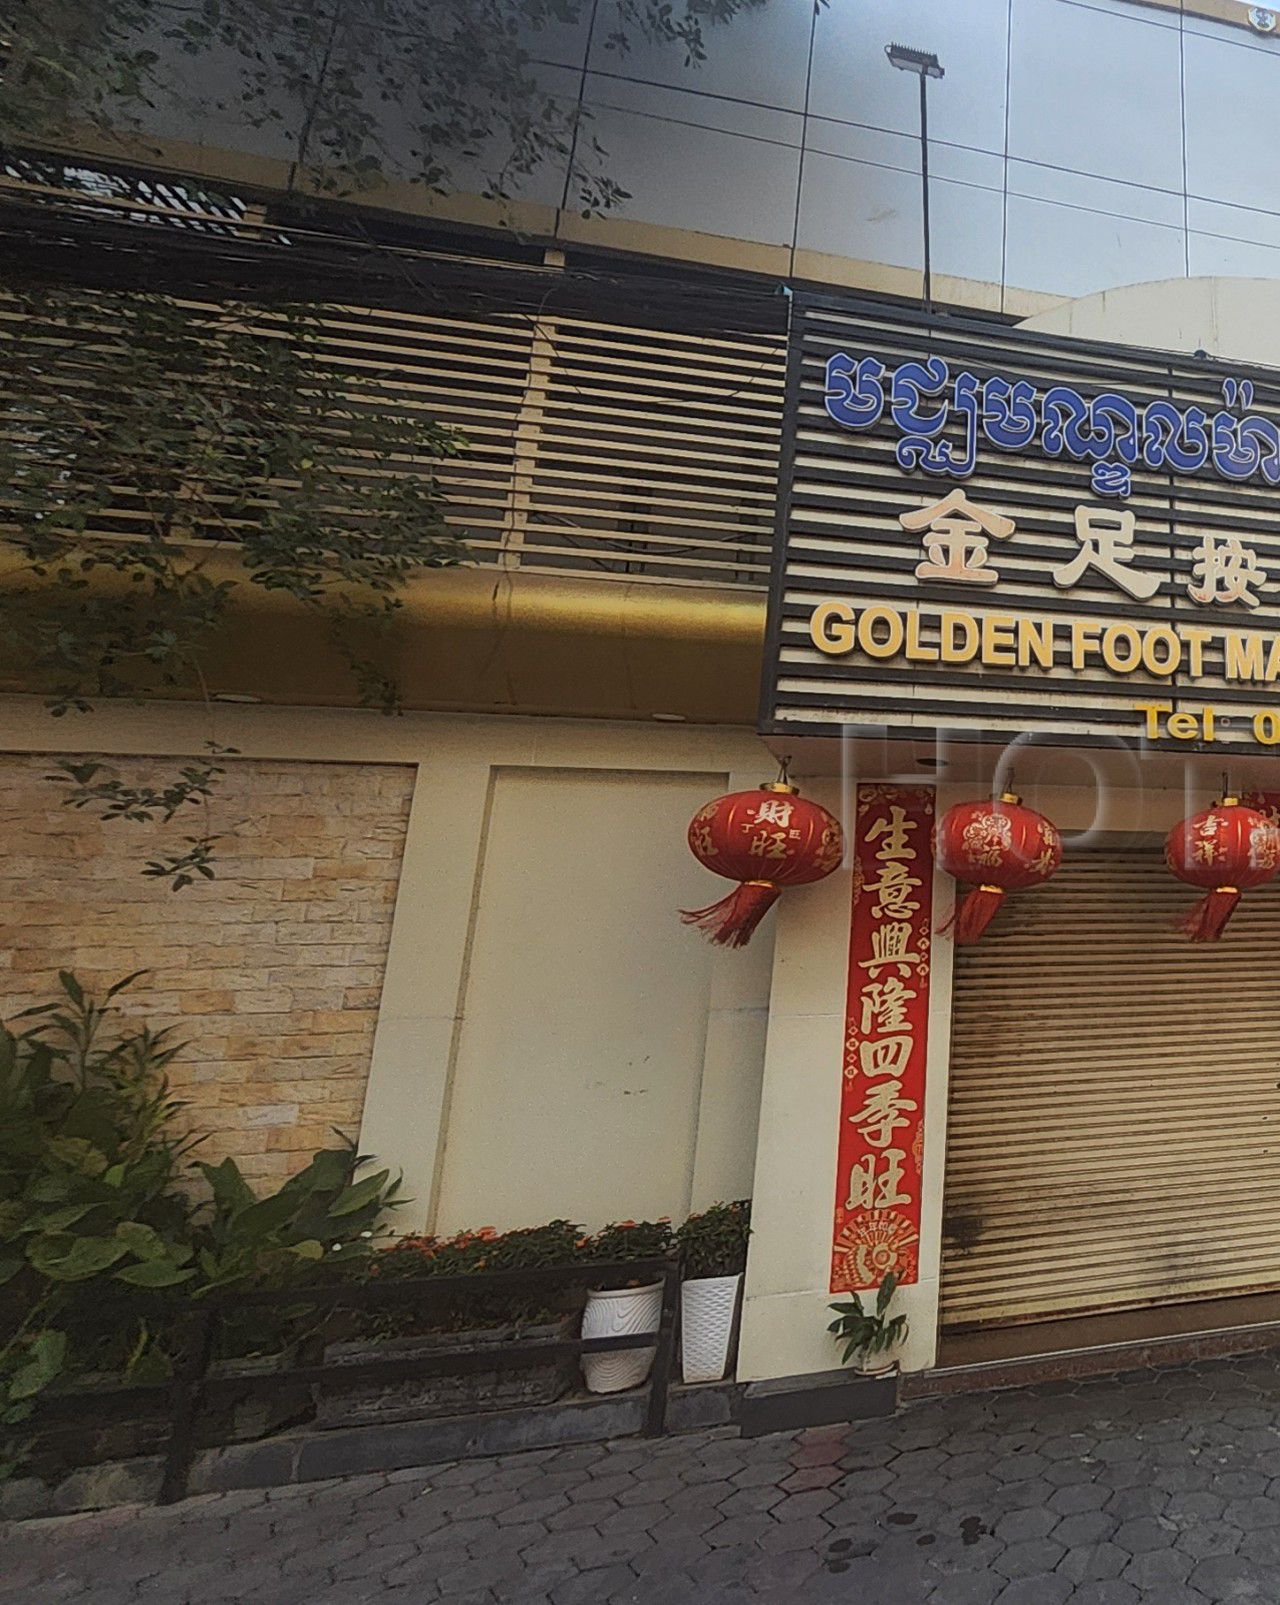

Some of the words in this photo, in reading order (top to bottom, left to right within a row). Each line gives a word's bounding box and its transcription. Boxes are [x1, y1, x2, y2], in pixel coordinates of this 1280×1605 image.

[809, 602, 1054, 669] GOLDEN
[1072, 622, 1212, 678] FOOT
[845, 805, 922, 1211] 生意興隆四季旺
